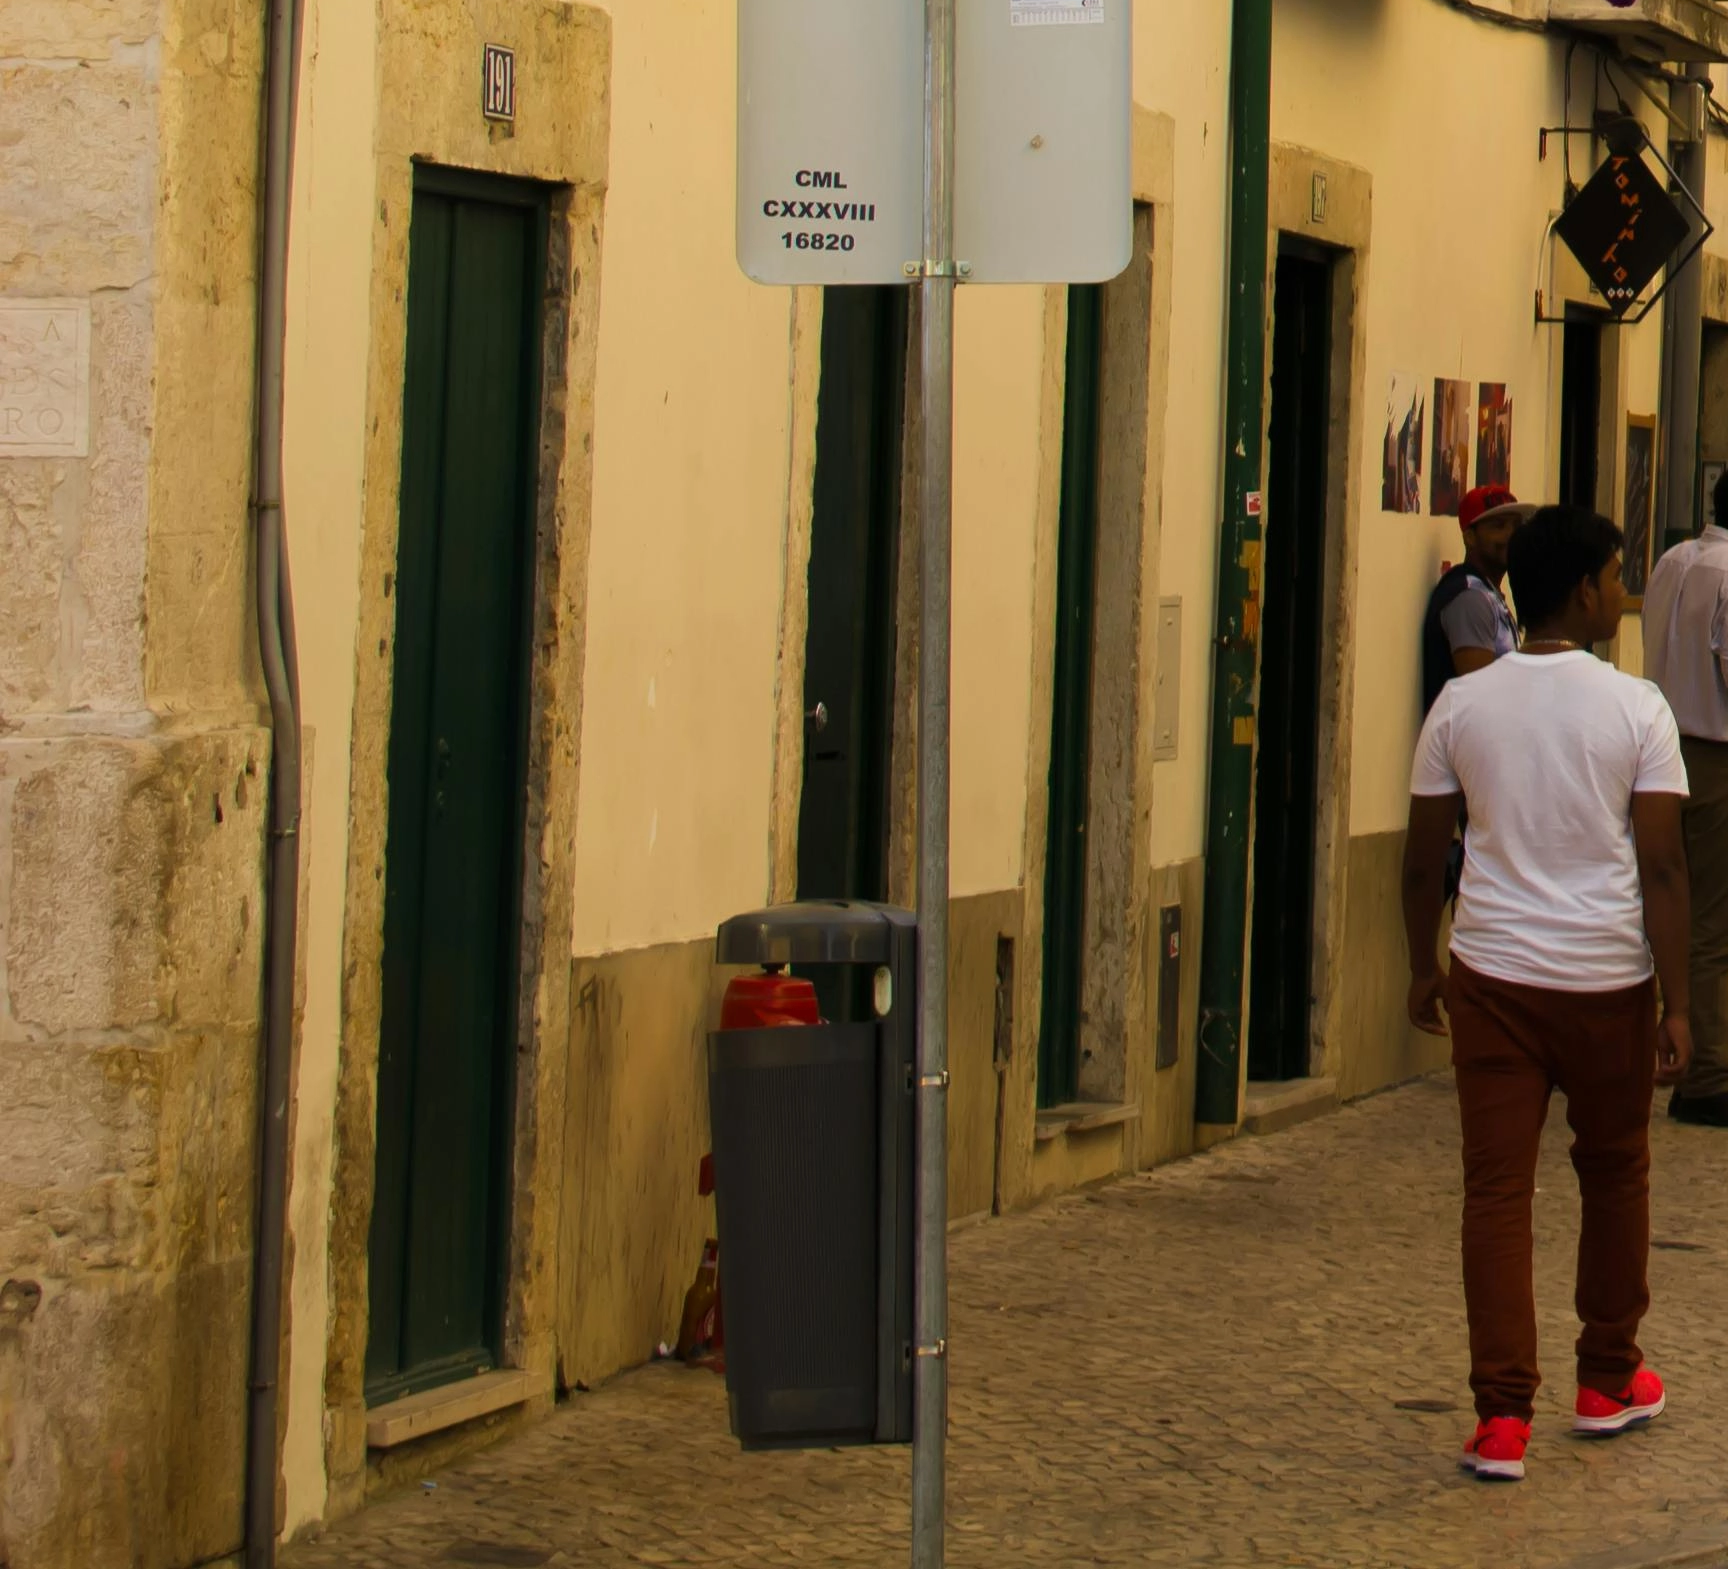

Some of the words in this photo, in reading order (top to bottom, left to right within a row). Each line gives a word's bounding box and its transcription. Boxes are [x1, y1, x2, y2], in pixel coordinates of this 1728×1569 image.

[487, 51, 511, 114] 191
[796, 170, 847, 189] CML
[763, 200, 875, 221] CXXXVIII
[782, 232, 854, 251] 16820
